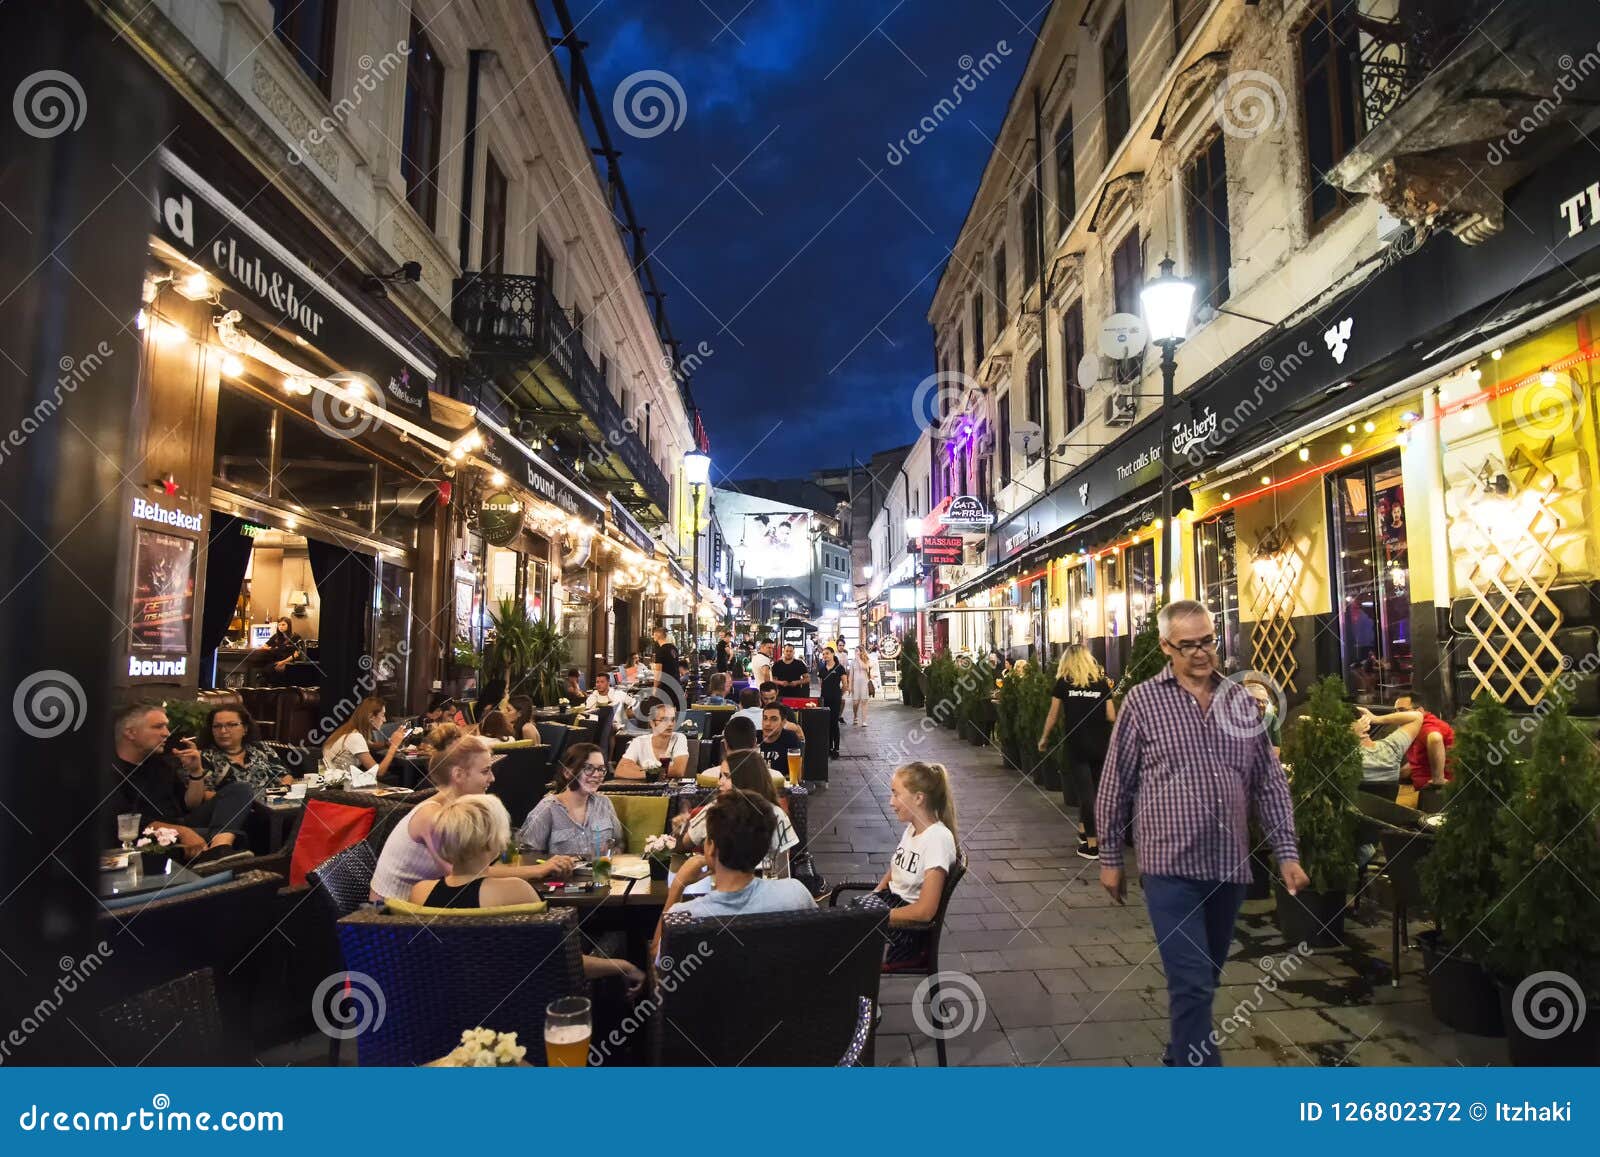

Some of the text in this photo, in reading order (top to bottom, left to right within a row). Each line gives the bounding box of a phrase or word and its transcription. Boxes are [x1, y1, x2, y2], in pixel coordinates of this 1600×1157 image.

[213, 238, 323, 336] club&bar
[1117, 406, 1217, 480] That calls for Carlsberg
[527, 462, 555, 500] bound
[132, 497, 203, 532] Heineken
[953, 501, 977, 509] CATS
[924, 537, 962, 545] MASSAGE
[128, 655, 187, 676] bound
